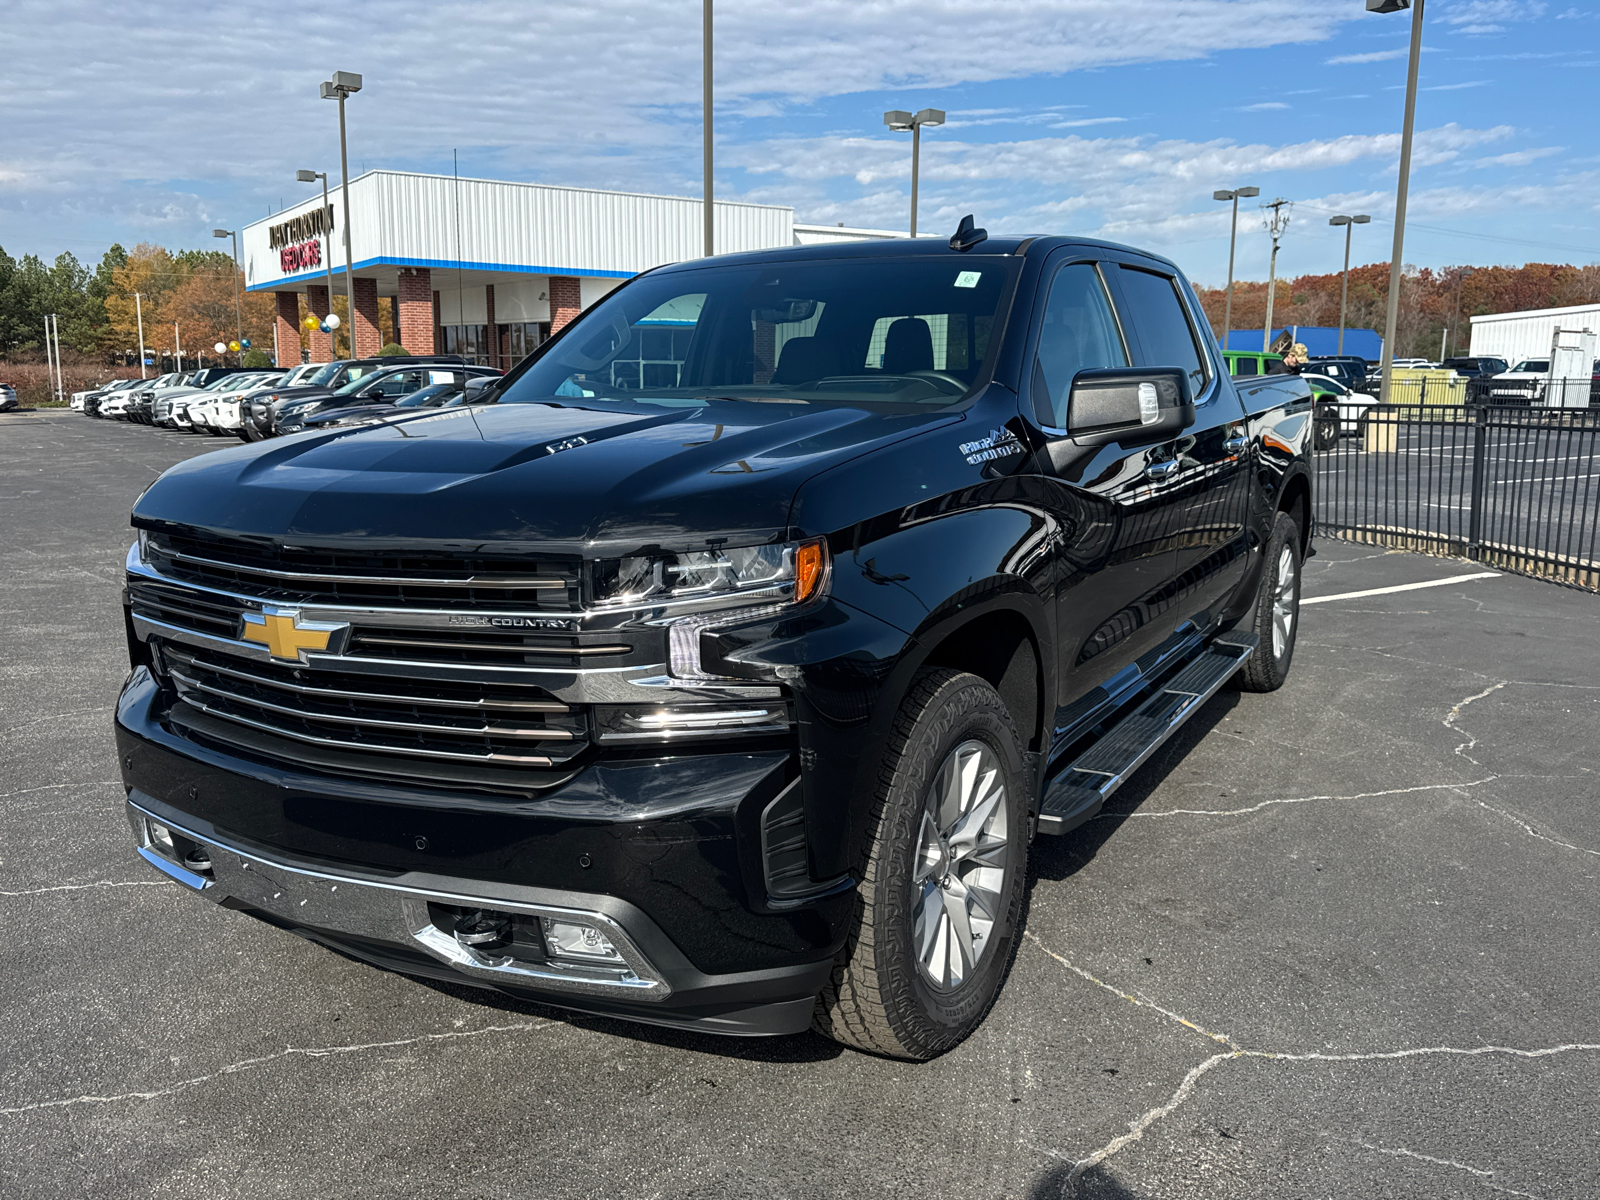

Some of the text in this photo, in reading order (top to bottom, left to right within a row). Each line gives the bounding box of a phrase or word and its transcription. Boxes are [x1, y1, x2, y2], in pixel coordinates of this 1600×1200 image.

[287, 203, 334, 243] THORNTON
[280, 239, 320, 273] USED CARS
[449, 616, 570, 628] HIGH COUNTRY
